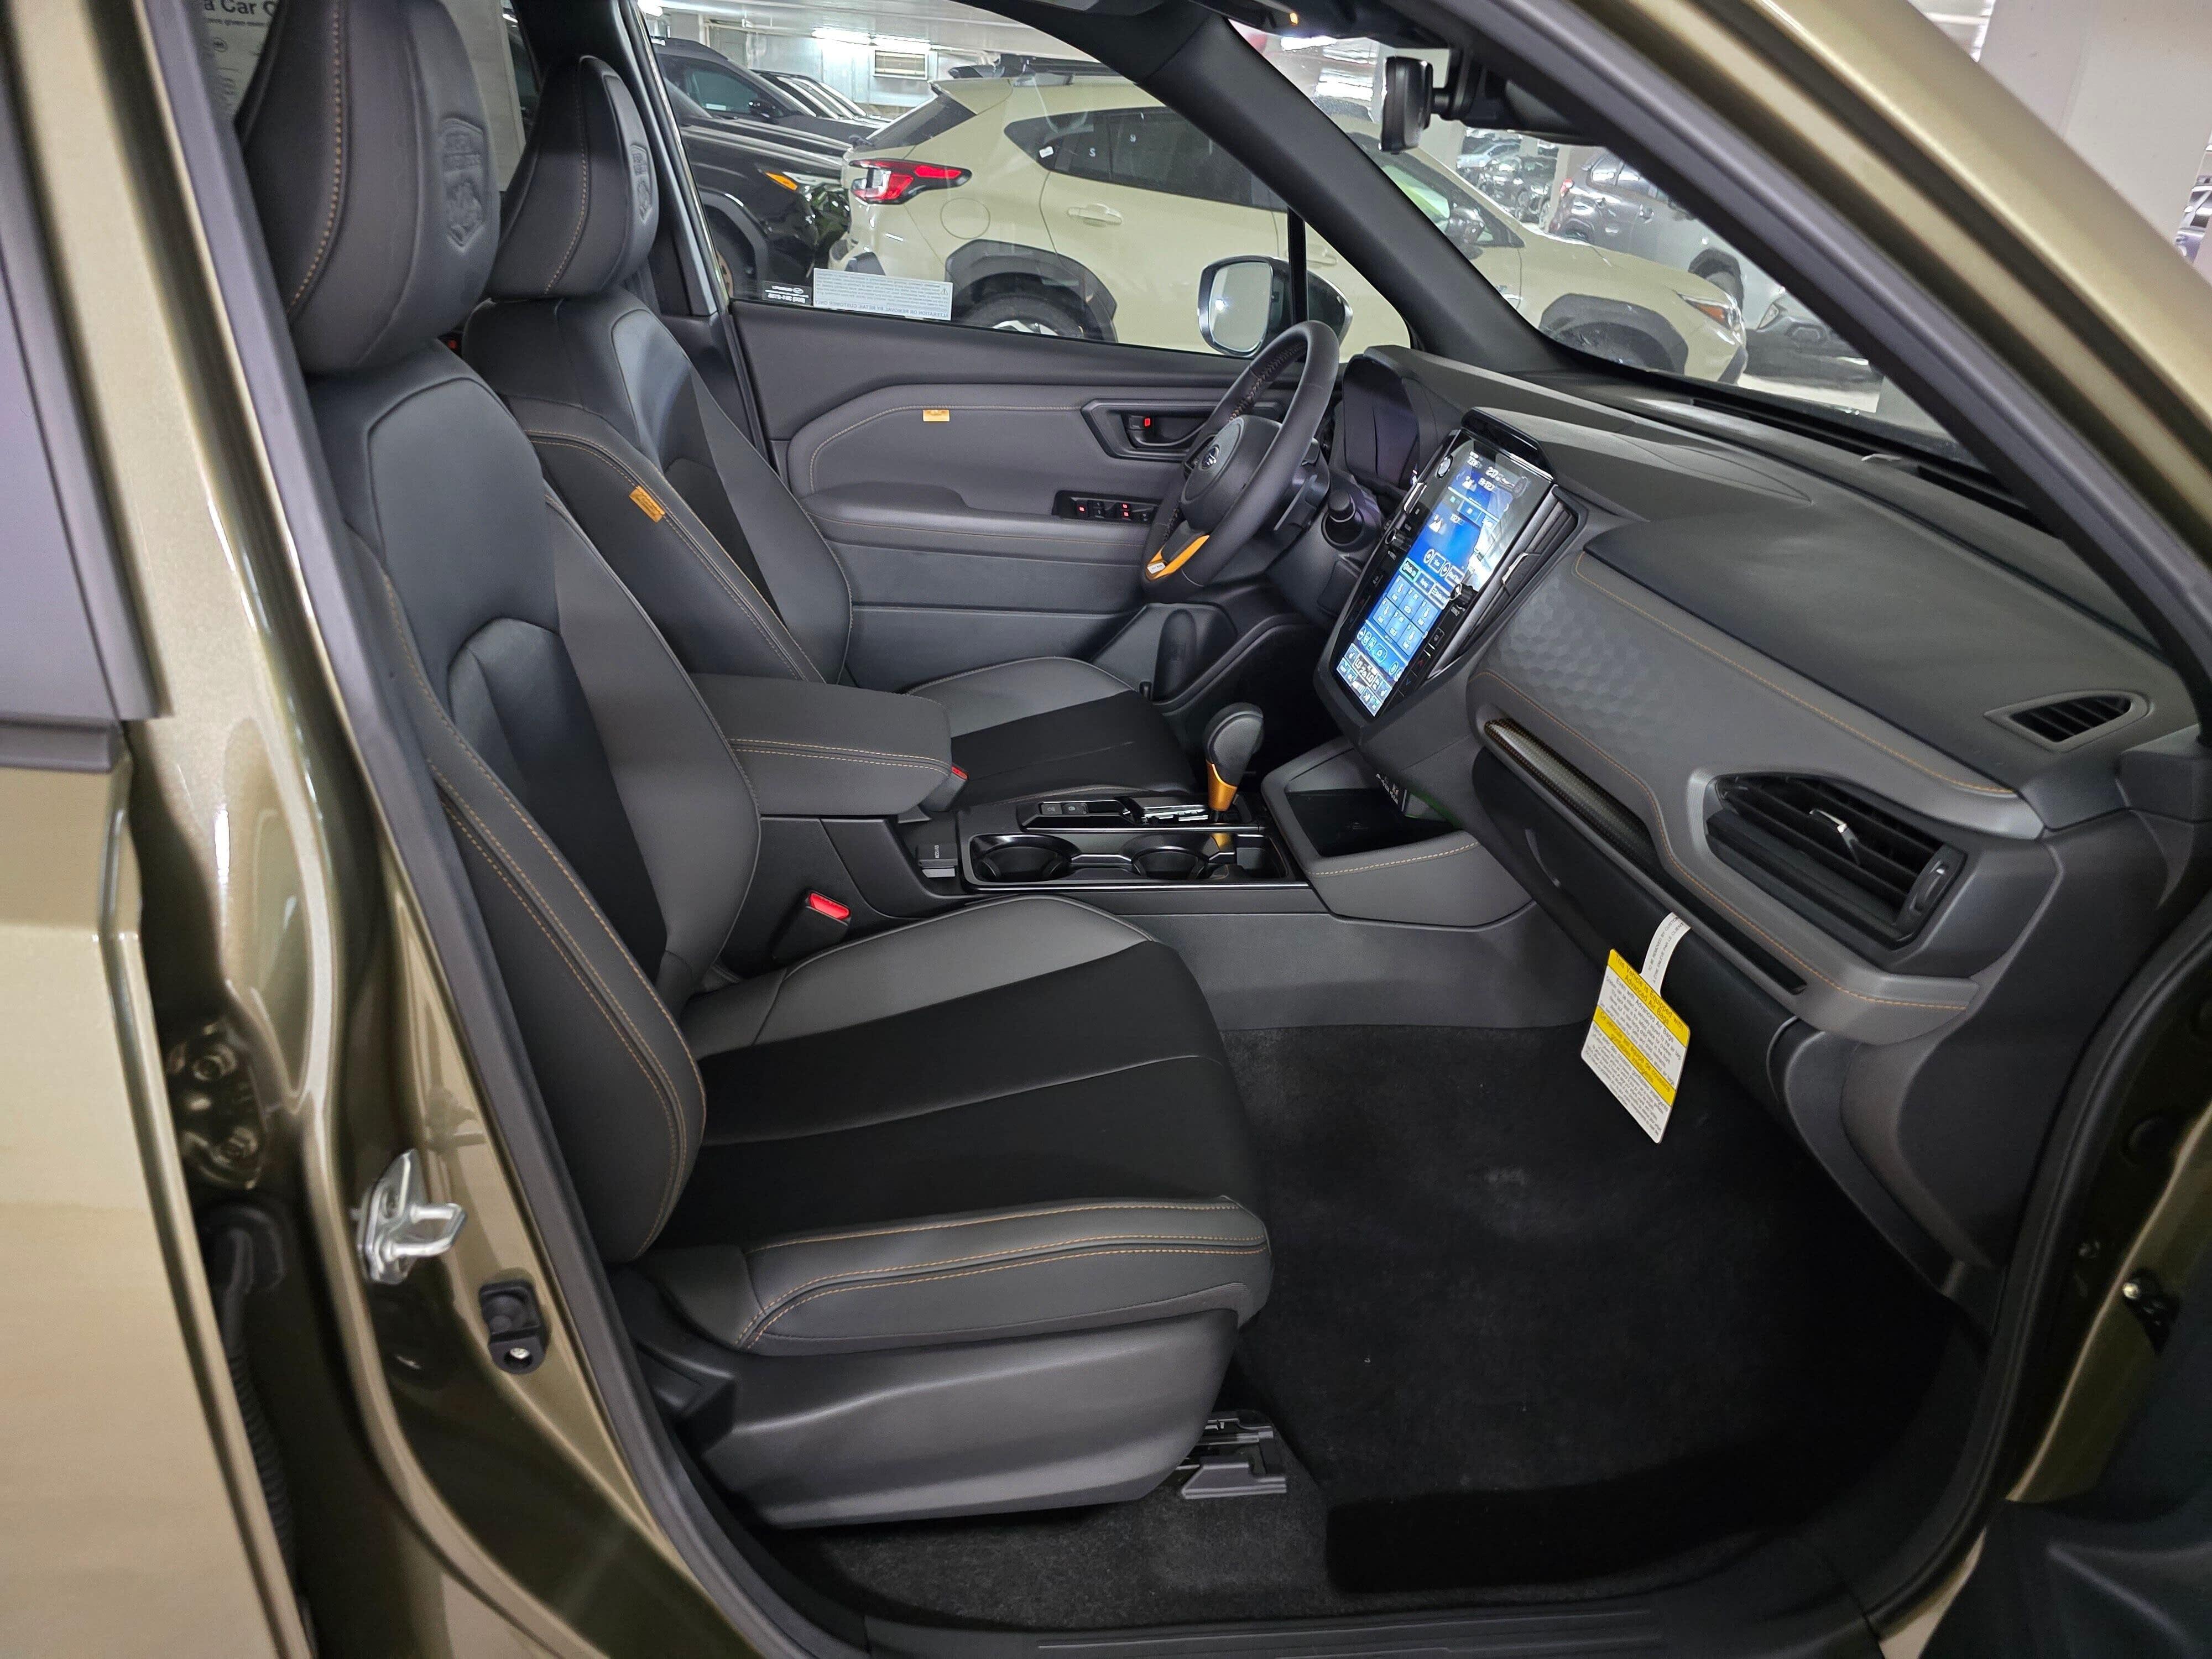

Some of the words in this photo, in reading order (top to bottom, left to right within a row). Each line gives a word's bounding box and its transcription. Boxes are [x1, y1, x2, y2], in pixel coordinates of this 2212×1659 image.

[220, 0, 257, 14] Car
[1672, 922, 1683, 935] CLIENT
[1652, 938, 1662, 958] REMOVED
[1616, 955, 1624, 968] This
[1626, 966, 1642, 987] Vehicle
[1650, 991, 1671, 1019] Equipped
[1674, 1017, 1682, 1029] with
[1625, 974, 1646, 1000] Advanced
[1657, 1008, 1668, 1026] Bags
[1617, 978, 1625, 990] Even
[1636, 999, 1654, 1021] Advanced
[1663, 1028, 1673, 1043] Bags
